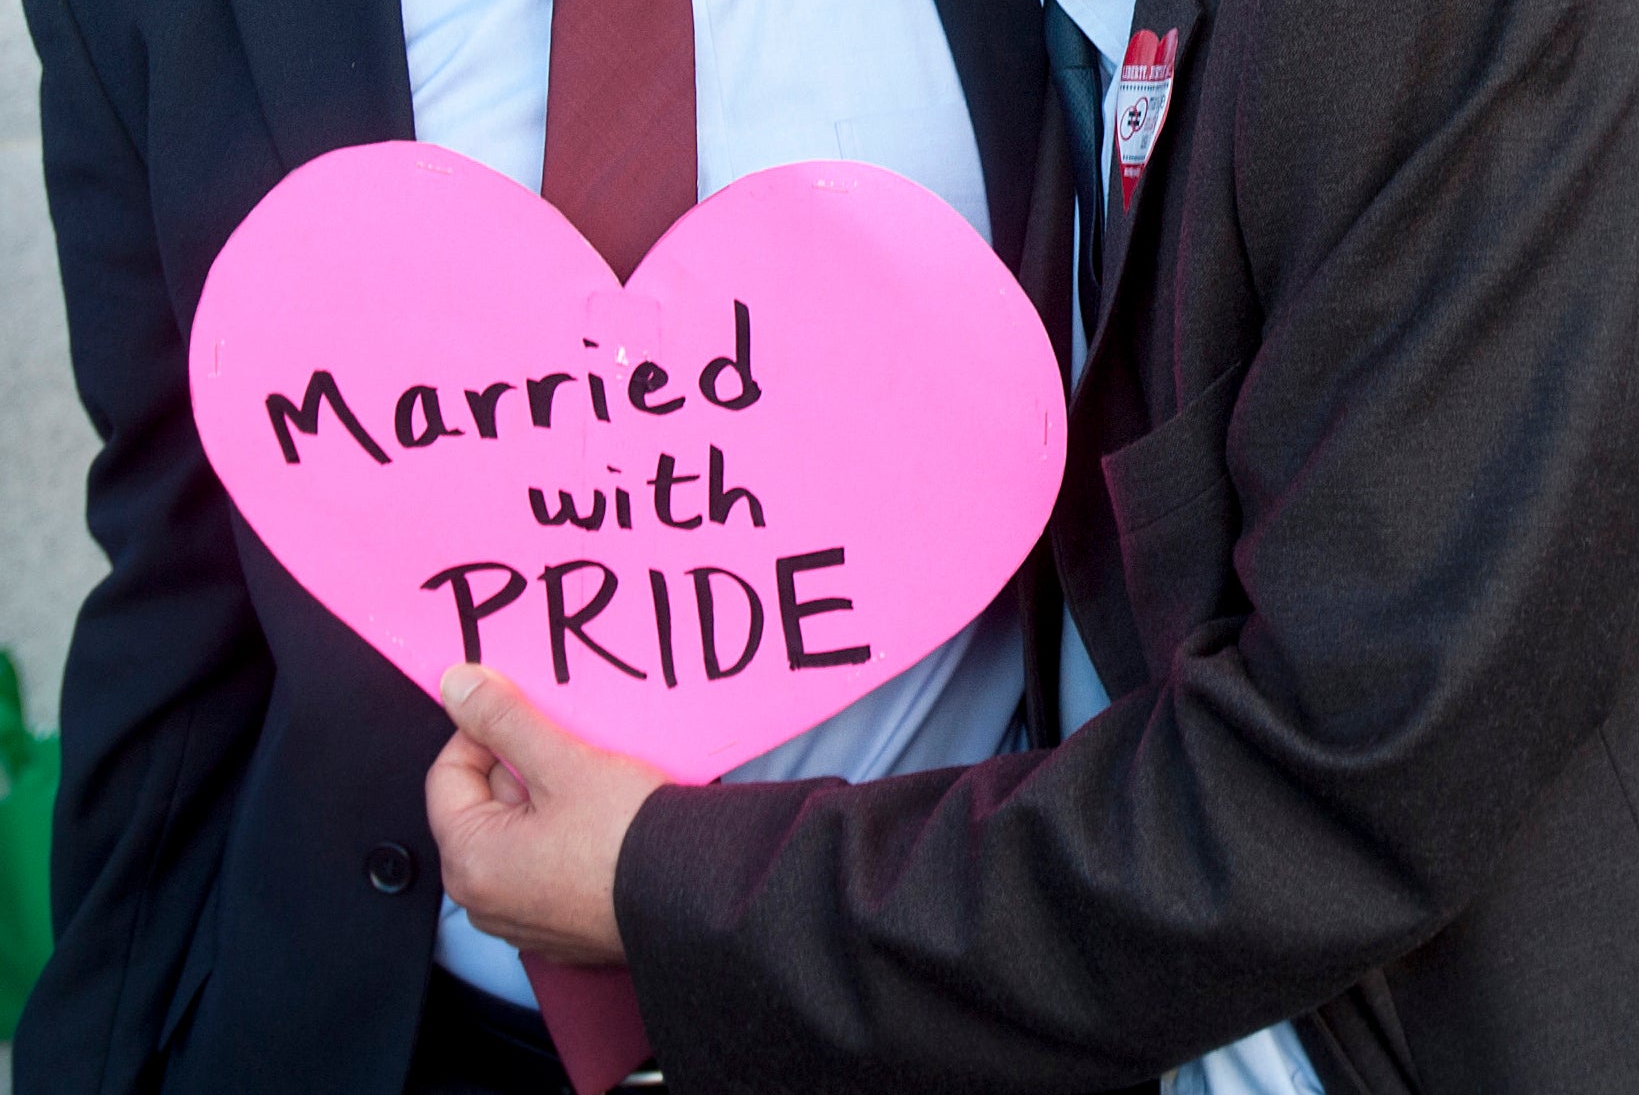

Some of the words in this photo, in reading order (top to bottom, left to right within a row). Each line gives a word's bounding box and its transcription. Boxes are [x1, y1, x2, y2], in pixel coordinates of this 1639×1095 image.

[265, 300, 763, 465] Married
[528, 446, 765, 532] with
[420, 547, 871, 689] PRIDE
